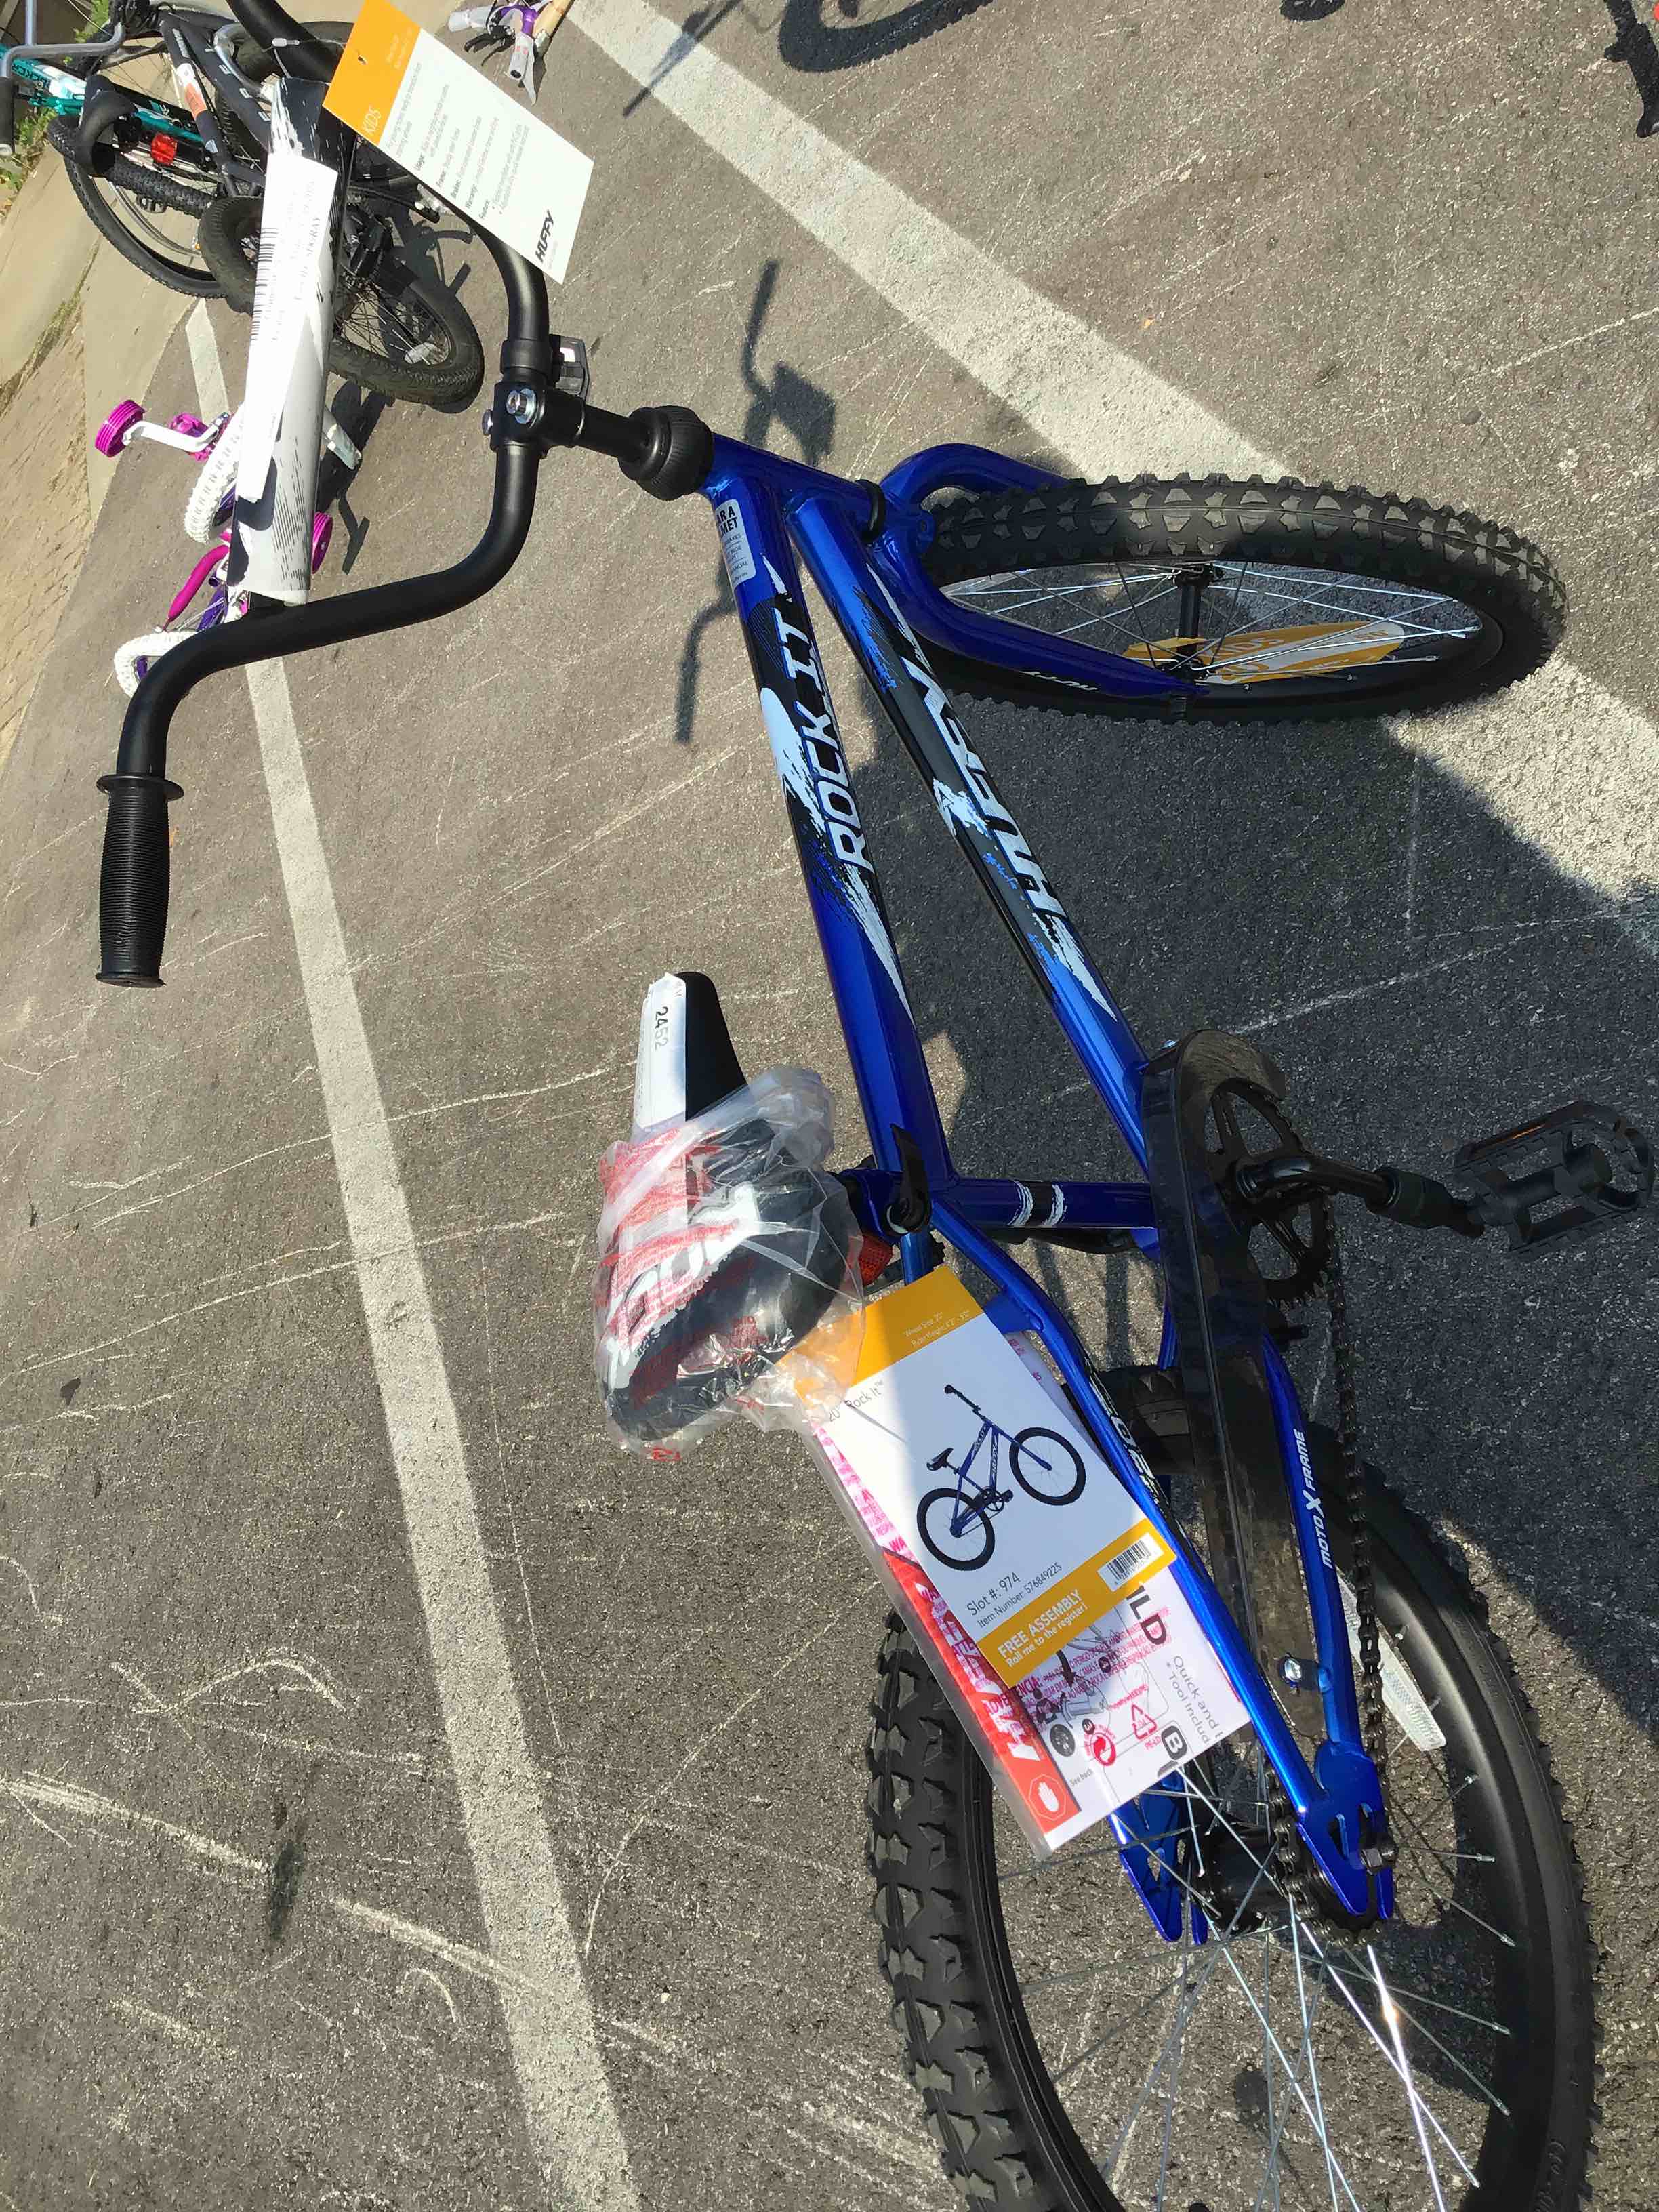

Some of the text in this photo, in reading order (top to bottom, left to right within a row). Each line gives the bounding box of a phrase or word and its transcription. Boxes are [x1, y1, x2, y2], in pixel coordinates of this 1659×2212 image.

[362, 108, 382, 134] KIDS
[535, 209, 554, 263] HUFFY
[773, 607, 874, 872] ROCK IT
[901, 656, 1067, 918] HUFFY
[844, 1392, 872, 1410] Rock
[1292, 1428, 1333, 1569] MOTO X FRAME
[966, 1572, 1021, 1616] Slot #: 974
[977, 1612, 996, 1628] Item
[1023, 1562, 1063, 1594] 576849225
[998, 1631, 1029, 1657] FREE
[1025, 1590, 1083, 1635] ASSEMBLY
[1005, 1600, 1090, 1667] Roll me to the register!
[1168, 1671, 1188, 1702] Tool
[1173, 1656, 1200, 1699] Quick
[1197, 1701, 1220, 1729] and
[1165, 1731, 1183, 1754] B
